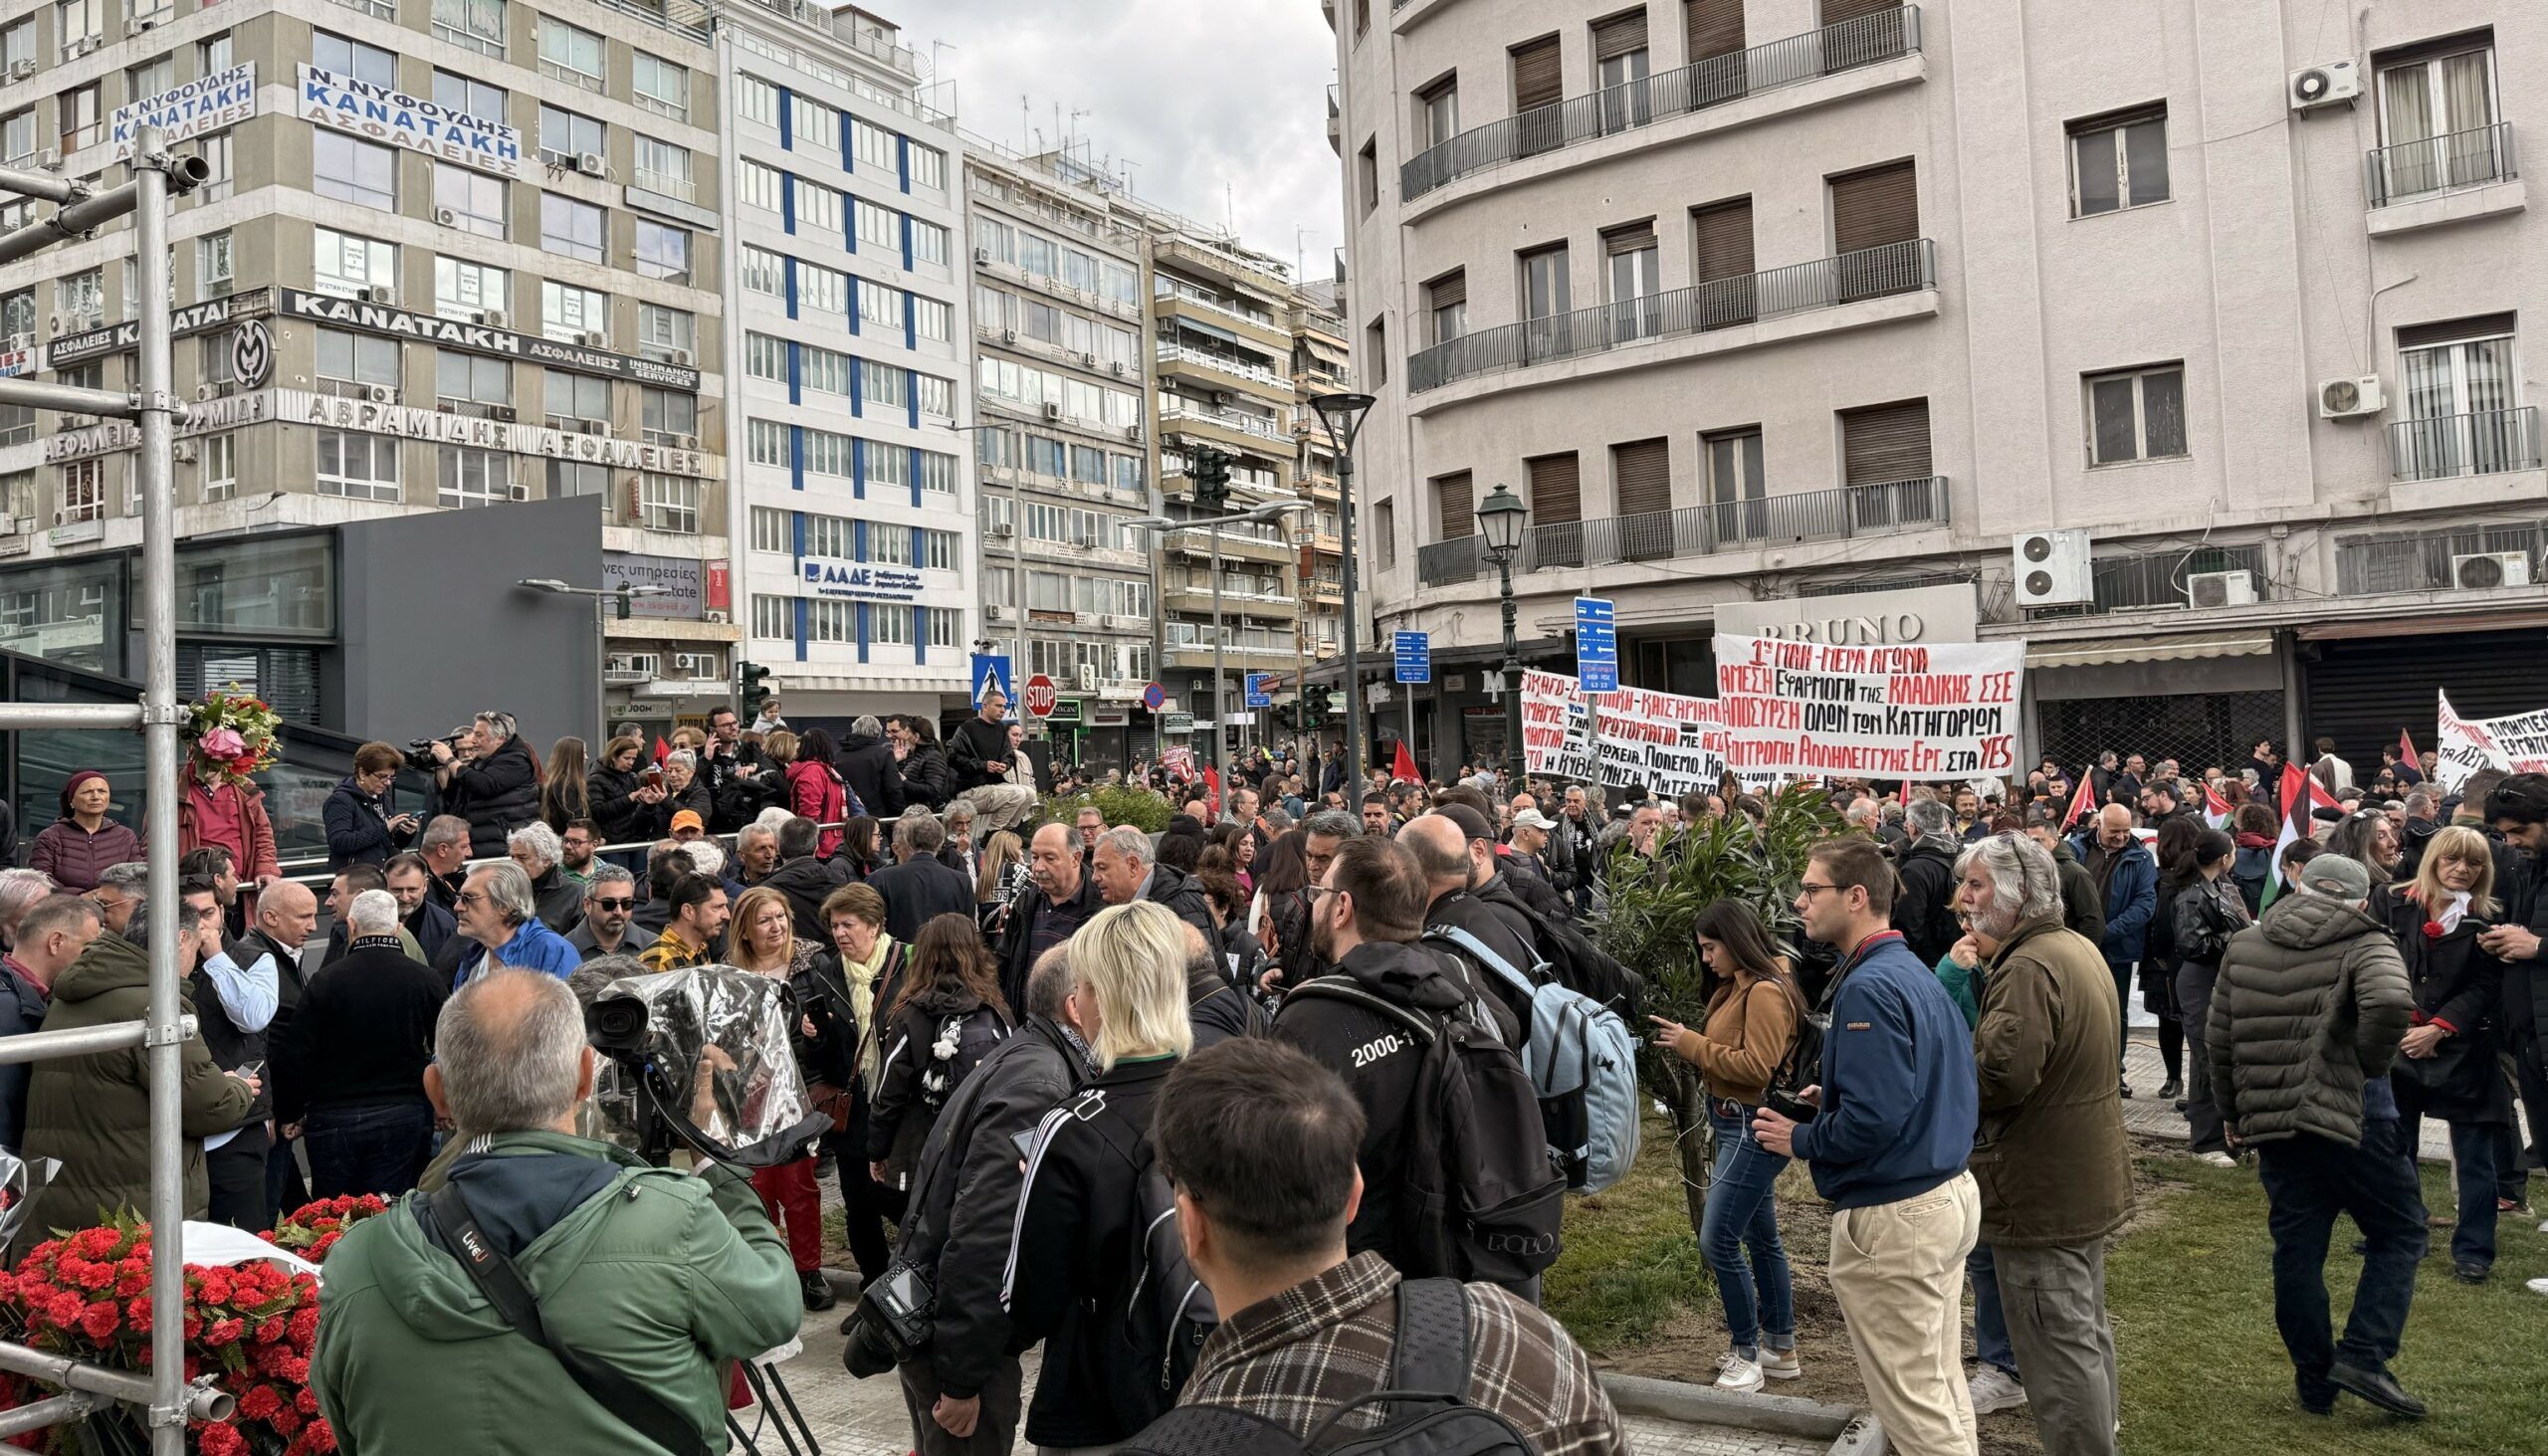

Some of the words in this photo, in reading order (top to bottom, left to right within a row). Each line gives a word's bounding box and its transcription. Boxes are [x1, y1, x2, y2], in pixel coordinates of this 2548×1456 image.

[114, 80, 251, 143] ΚΑΝΑΤΑΚΗ
[116, 106, 132, 122] Ν.
[138, 65, 247, 114] ΝΥΦΟΥΔΗΣ
[310, 67, 337, 87] Ν.
[349, 79, 514, 140] ΝΥΦΟΥΔΗΣ
[115, 103, 251, 159] ΑΑΛΕΙΕΣ
[307, 82, 517, 161] ΚΑΝΑΤΑΚΗ
[308, 106, 517, 176] ΑΣΦΑΛΕΙΕΣ
[53, 332, 111, 356] ΑΣΦΑΛΕΙΕΣ
[295, 293, 519, 354] ΚΑΝΑΤΑΚΗ
[530, 342, 621, 371] ΑΣΦΑΛΕΙΕΣ
[629, 359, 697, 381] INSURANCE
[635, 369, 692, 387] SERVICES
[309, 397, 508, 449] ΑΒΡΑΜΙΔΗΣ
[538, 432, 702, 475] ΑΣΦΑΛΕΙΕΣ
[629, 565, 697, 583] υπηρεσίες
[824, 565, 872, 586] ΑΑΔΕ
[1757, 612, 1923, 645] BRUNO
[1027, 686, 1054, 708] STOP
[1720, 664, 1774, 695] ΑΜΕΣΗ
[1859, 686, 1885, 704] ΤΗΣ
[1888, 674, 1974, 706] ΚΛΑΔΙΚΗΣ
[1979, 671, 2016, 704] ΣΣΕ
[1722, 696, 1801, 730] ΑΠΟΣΥΡΣΗ
[1805, 703, 1848, 733] ΟΛΩΝ
[1852, 714, 1882, 734] ΤΩΝ
[1886, 706, 2003, 737] ΚΑΤΗΓΟΡΙΩΝ
[1589, 739, 1643, 767] ΤΩΧΕΙΑ,
[1679, 734, 1699, 748] ΜΕ
[1724, 731, 1796, 767] ΕΠΙΤΡΟΠΗ
[1799, 733, 1910, 772] ΑΛΛΗΛΕΓΓΥΗΣ
[1946, 750, 1978, 772] ΣΤΑ
[1979, 733, 2015, 771] YES
[1545, 755, 1555, 770] Η
[462, 1230, 489, 1262] LiveU
